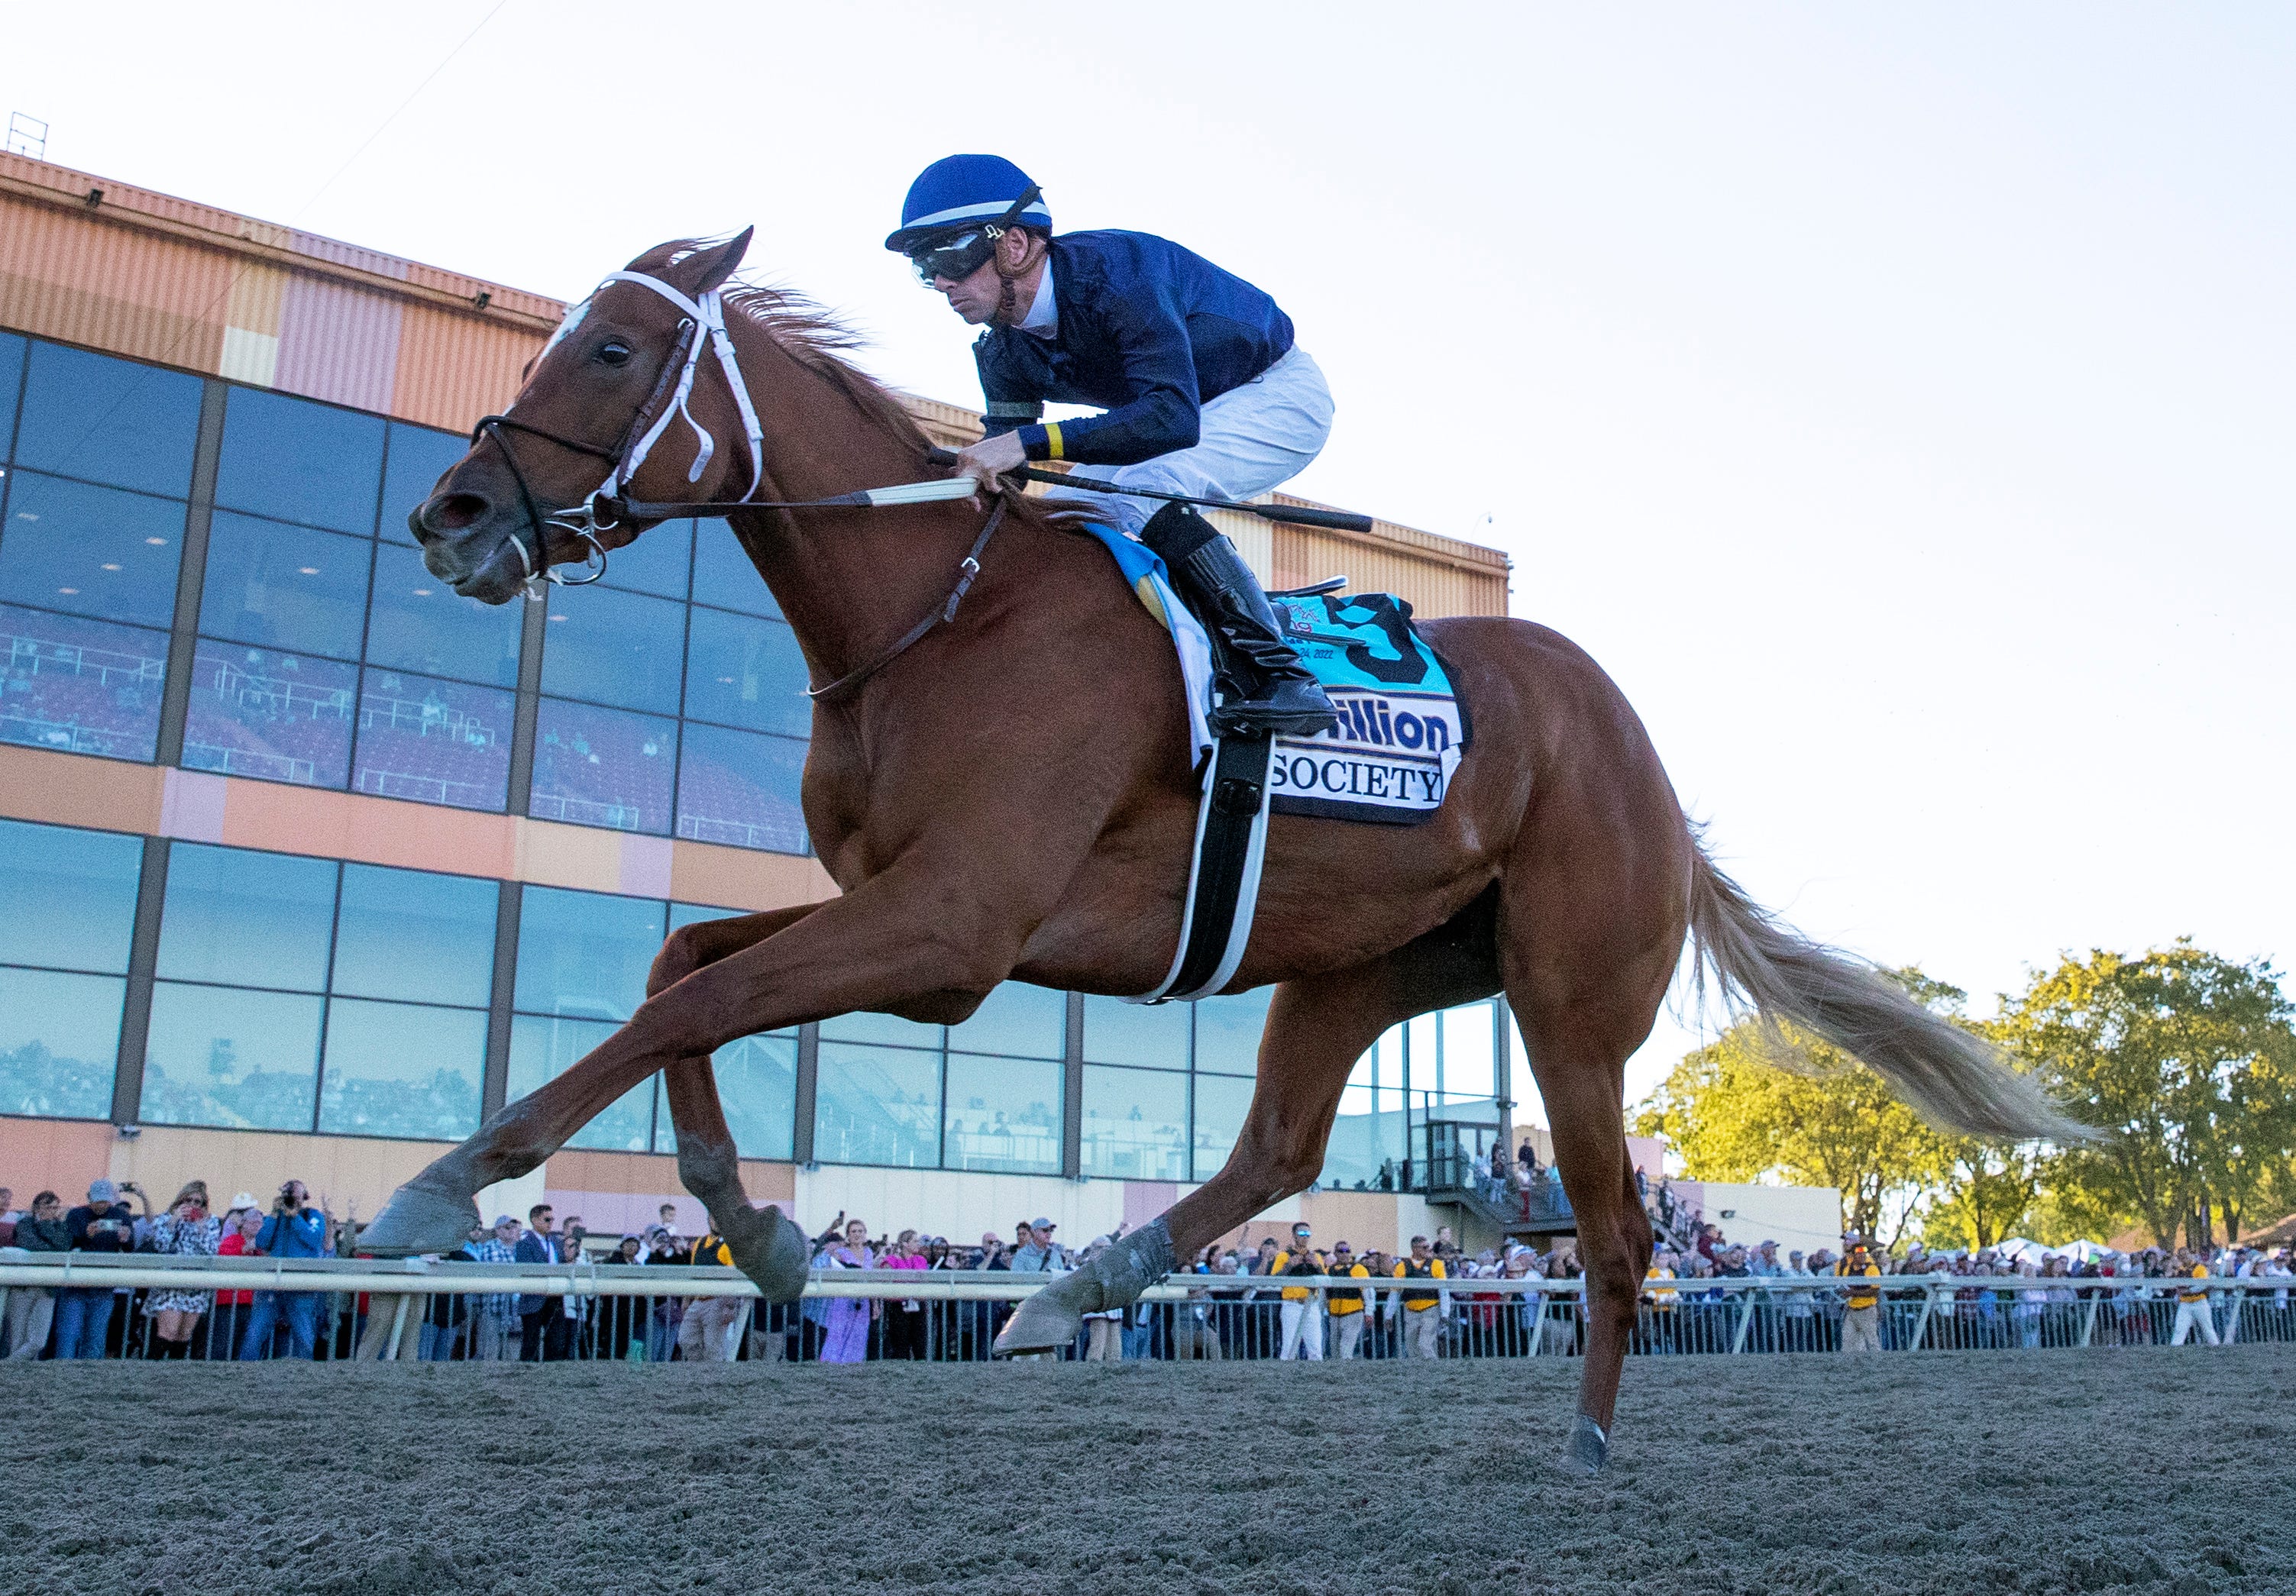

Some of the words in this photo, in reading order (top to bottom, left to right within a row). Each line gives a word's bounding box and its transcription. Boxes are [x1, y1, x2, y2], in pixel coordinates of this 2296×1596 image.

[1314, 649, 1334, 660] 2022
[1323, 593, 1428, 684] 3
[1328, 699, 1450, 752] illion
[1271, 754, 1441, 803] SOCIETY
